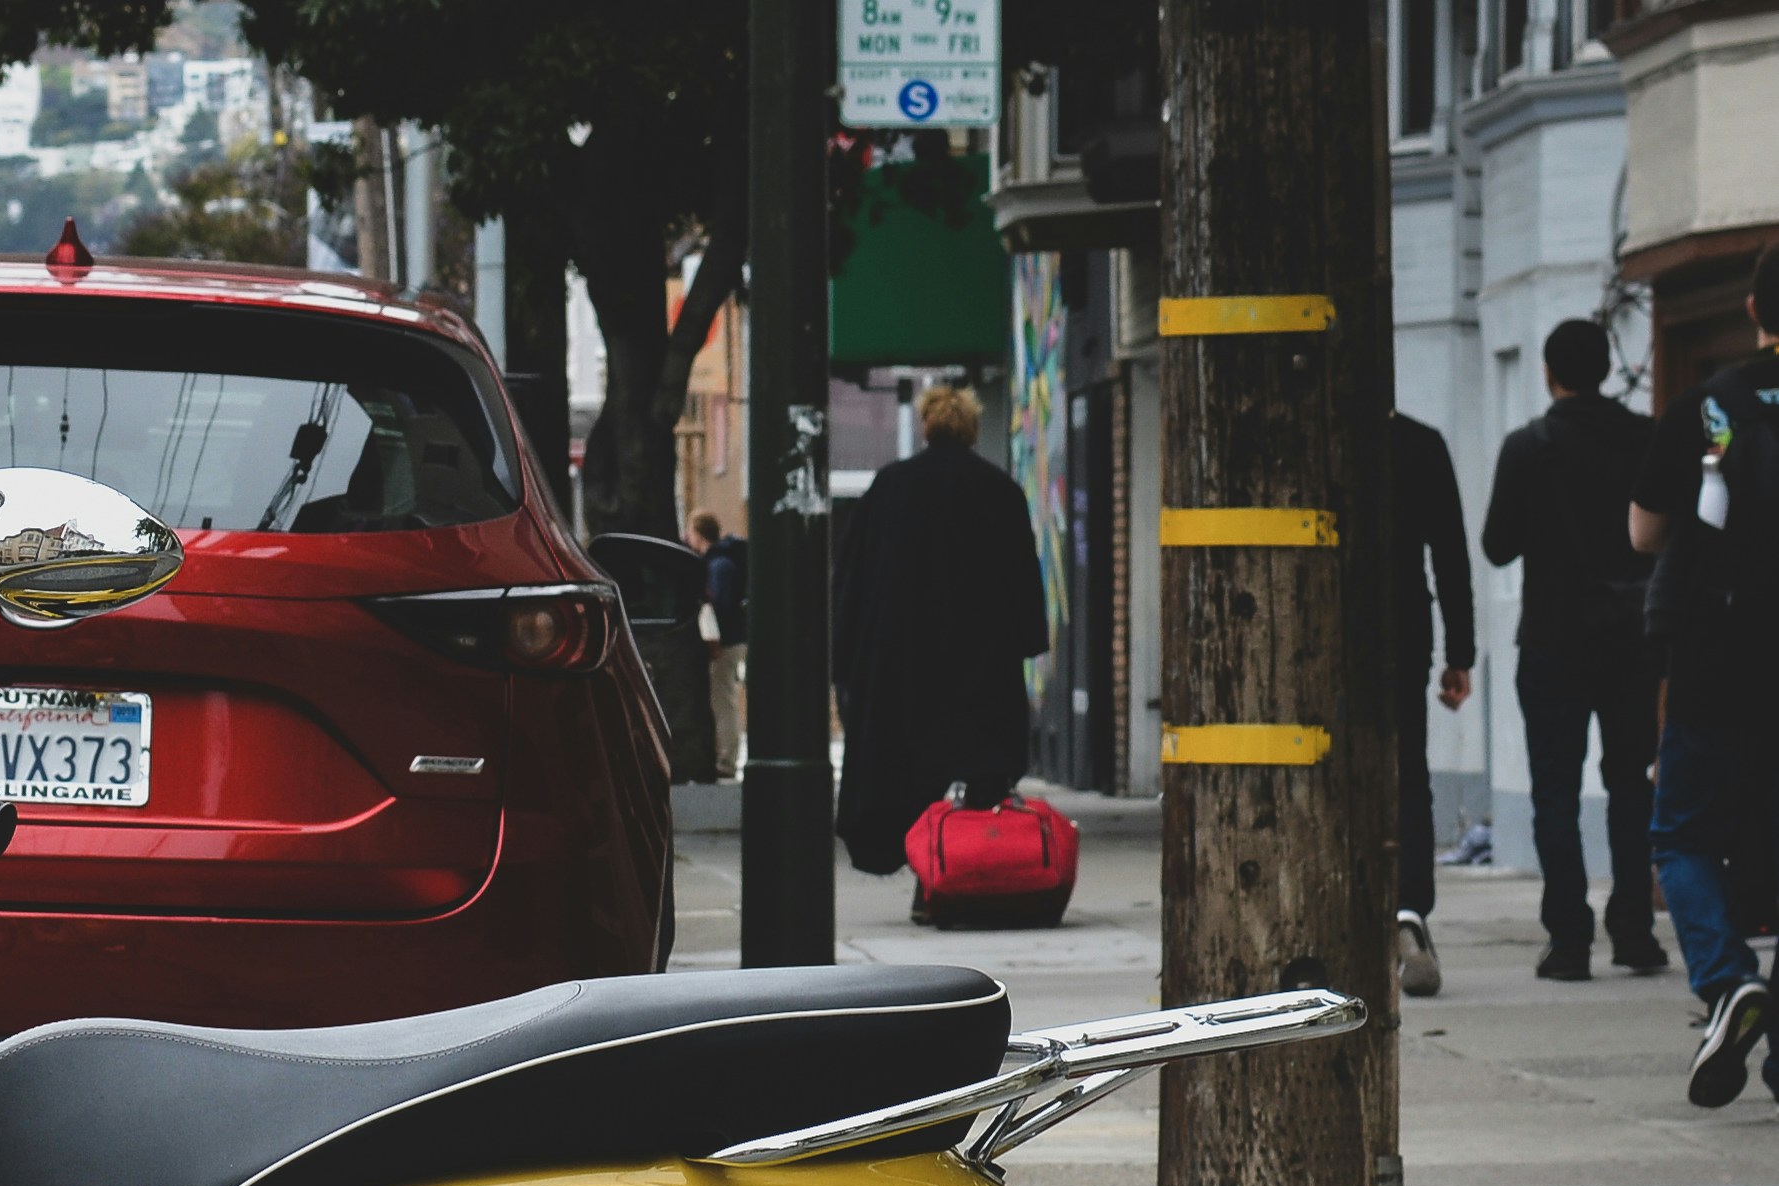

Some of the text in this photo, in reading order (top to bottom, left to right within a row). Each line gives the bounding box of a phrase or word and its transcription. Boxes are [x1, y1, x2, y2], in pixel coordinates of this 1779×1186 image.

[859, 34, 900, 53] MON
[948, 34, 980, 53] FRI
[907, 85, 930, 116] S
